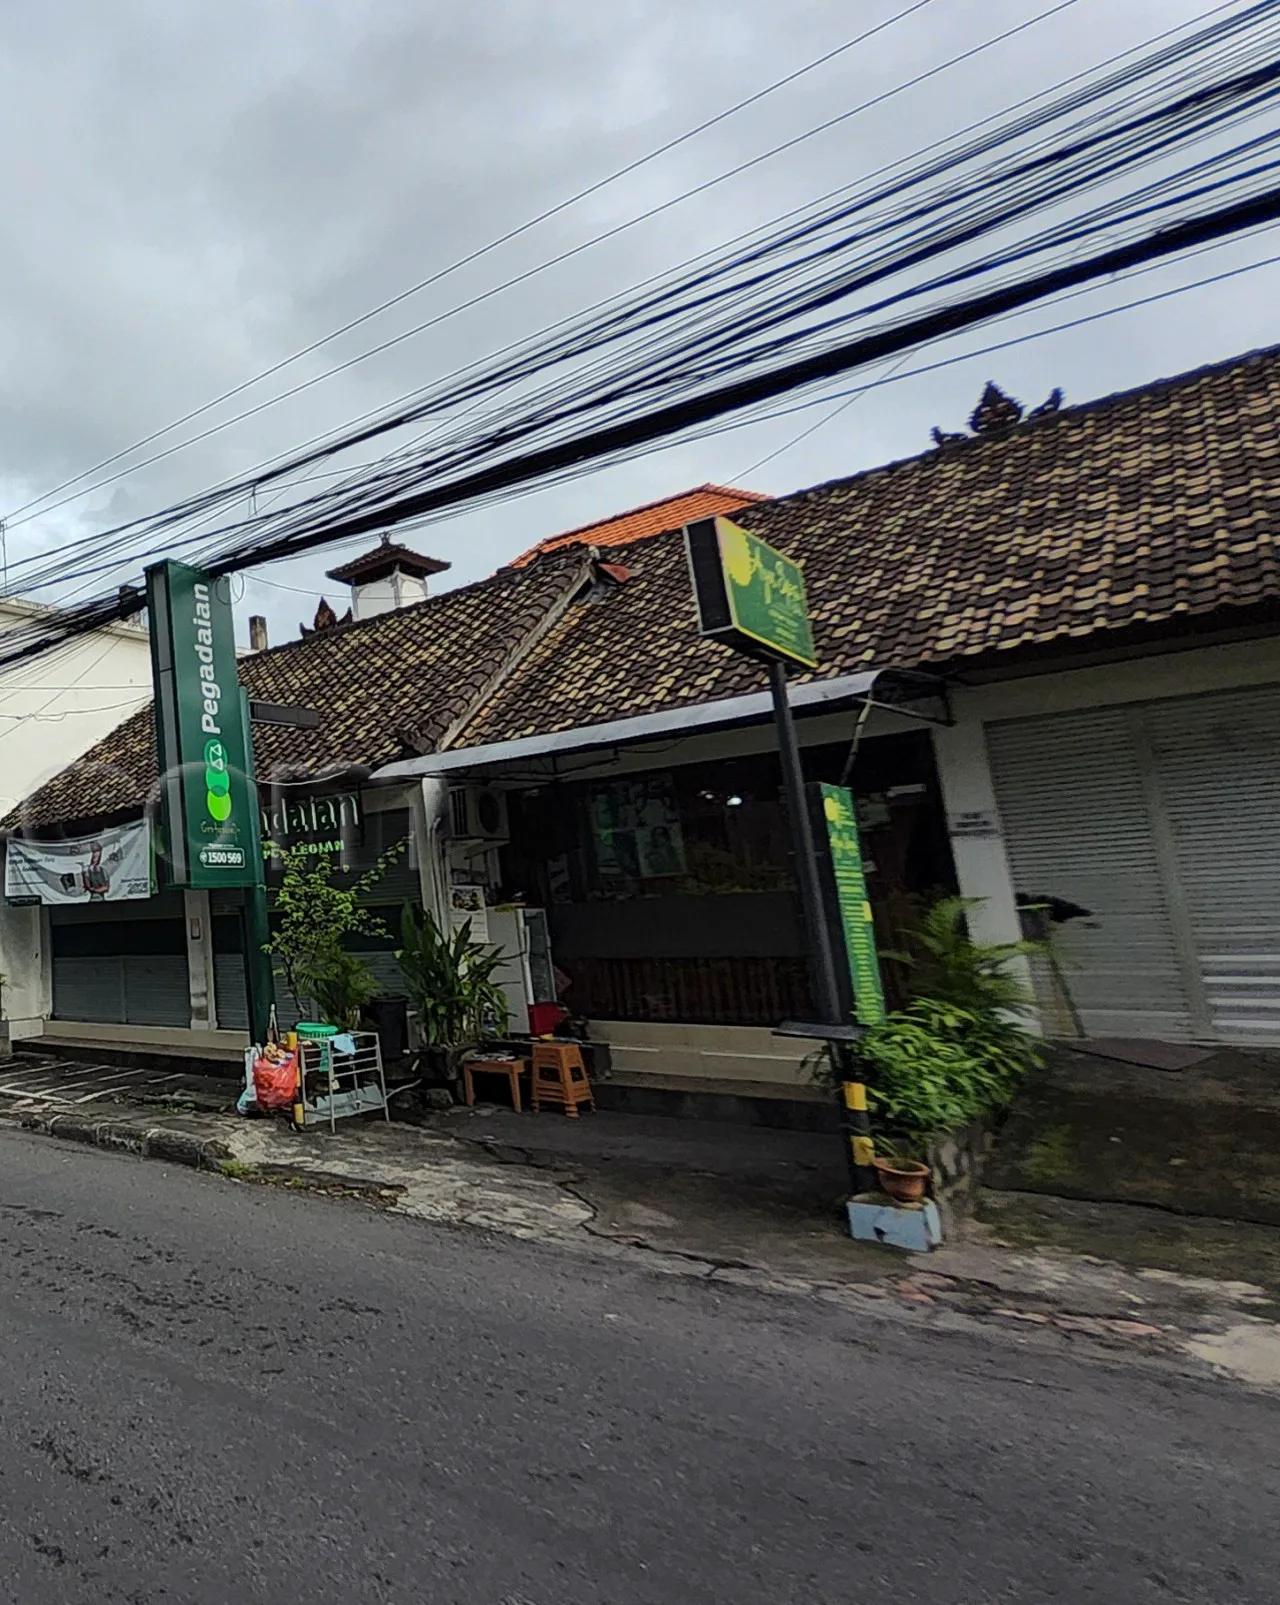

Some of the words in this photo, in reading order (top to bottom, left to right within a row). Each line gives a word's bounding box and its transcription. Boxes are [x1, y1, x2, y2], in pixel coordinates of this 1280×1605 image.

[193, 583, 221, 735] Pegadaian
[208, 851, 227, 863] 1500
[227, 852, 242, 864] 569
